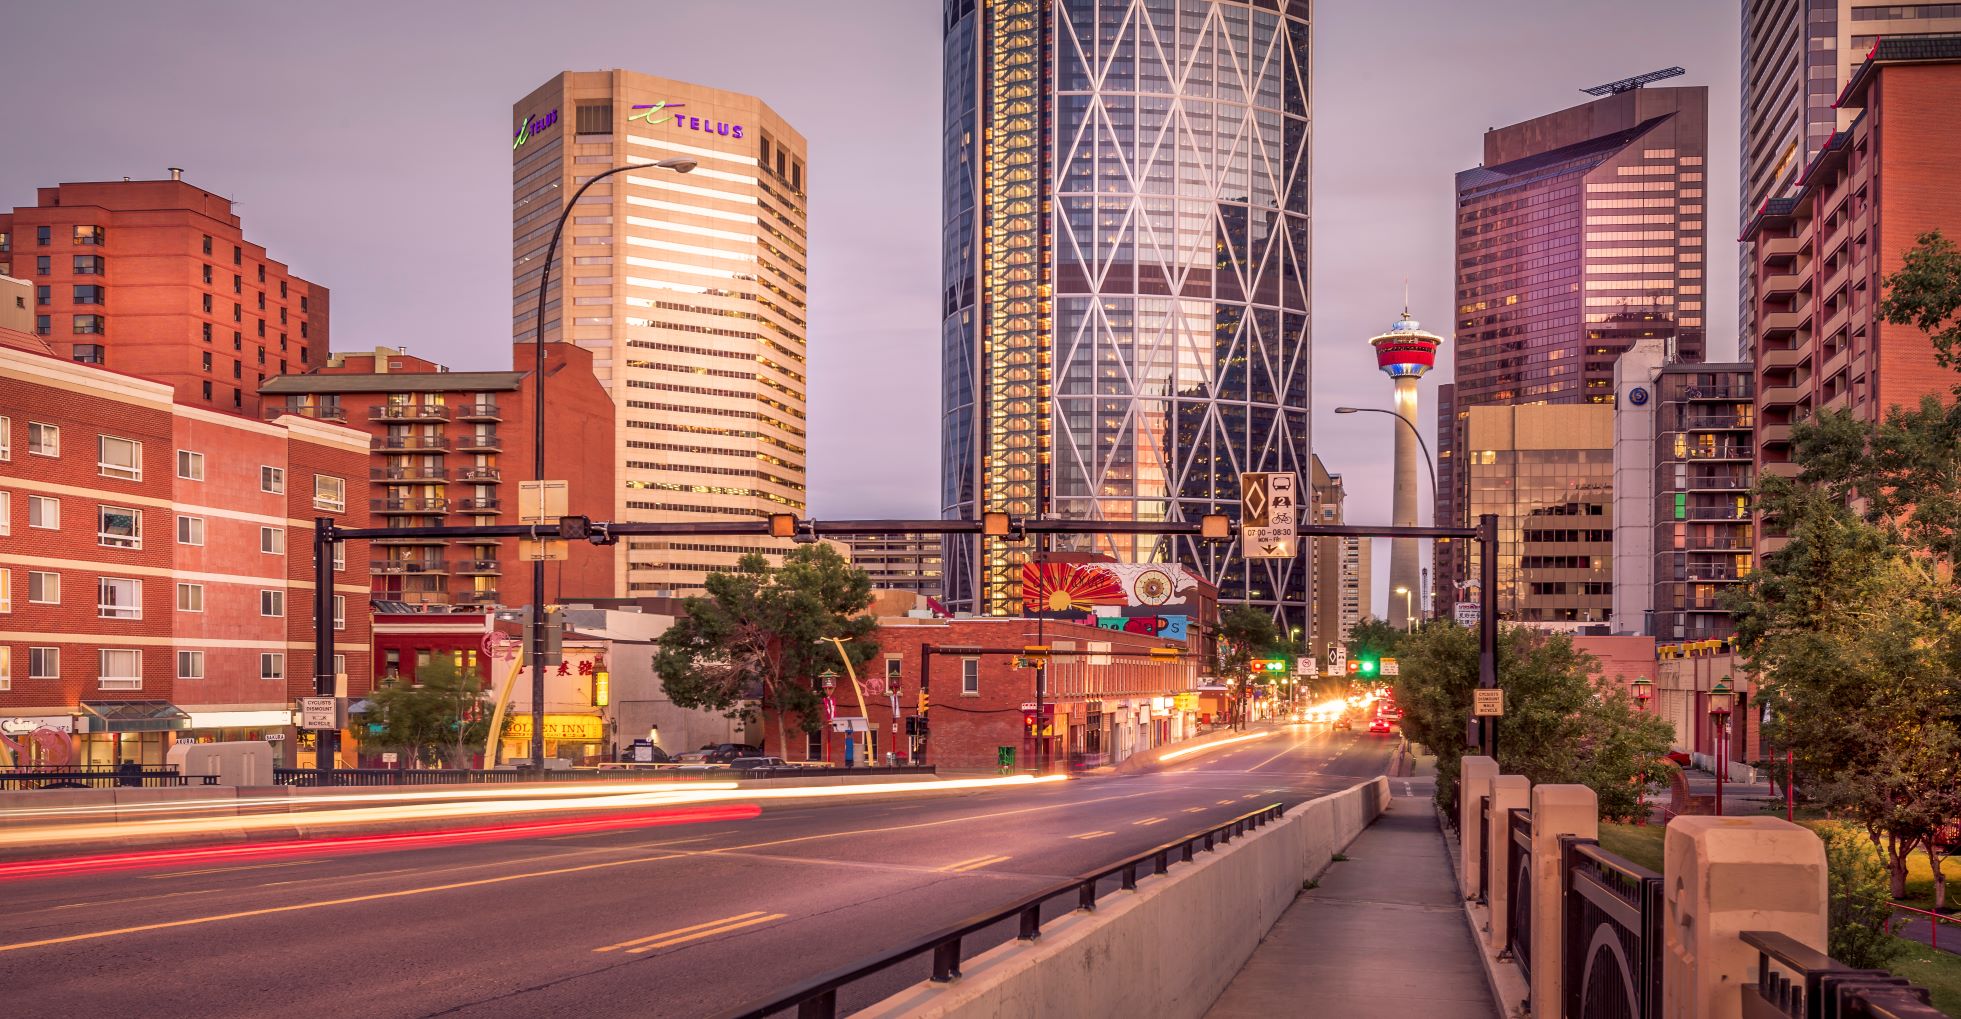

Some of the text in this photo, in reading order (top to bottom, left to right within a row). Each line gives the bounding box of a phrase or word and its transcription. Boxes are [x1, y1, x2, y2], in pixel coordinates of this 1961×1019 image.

[529, 108, 558, 137] TELUS
[674, 114, 744, 139] TELUS
[507, 723, 585, 733] GOLEN INN
